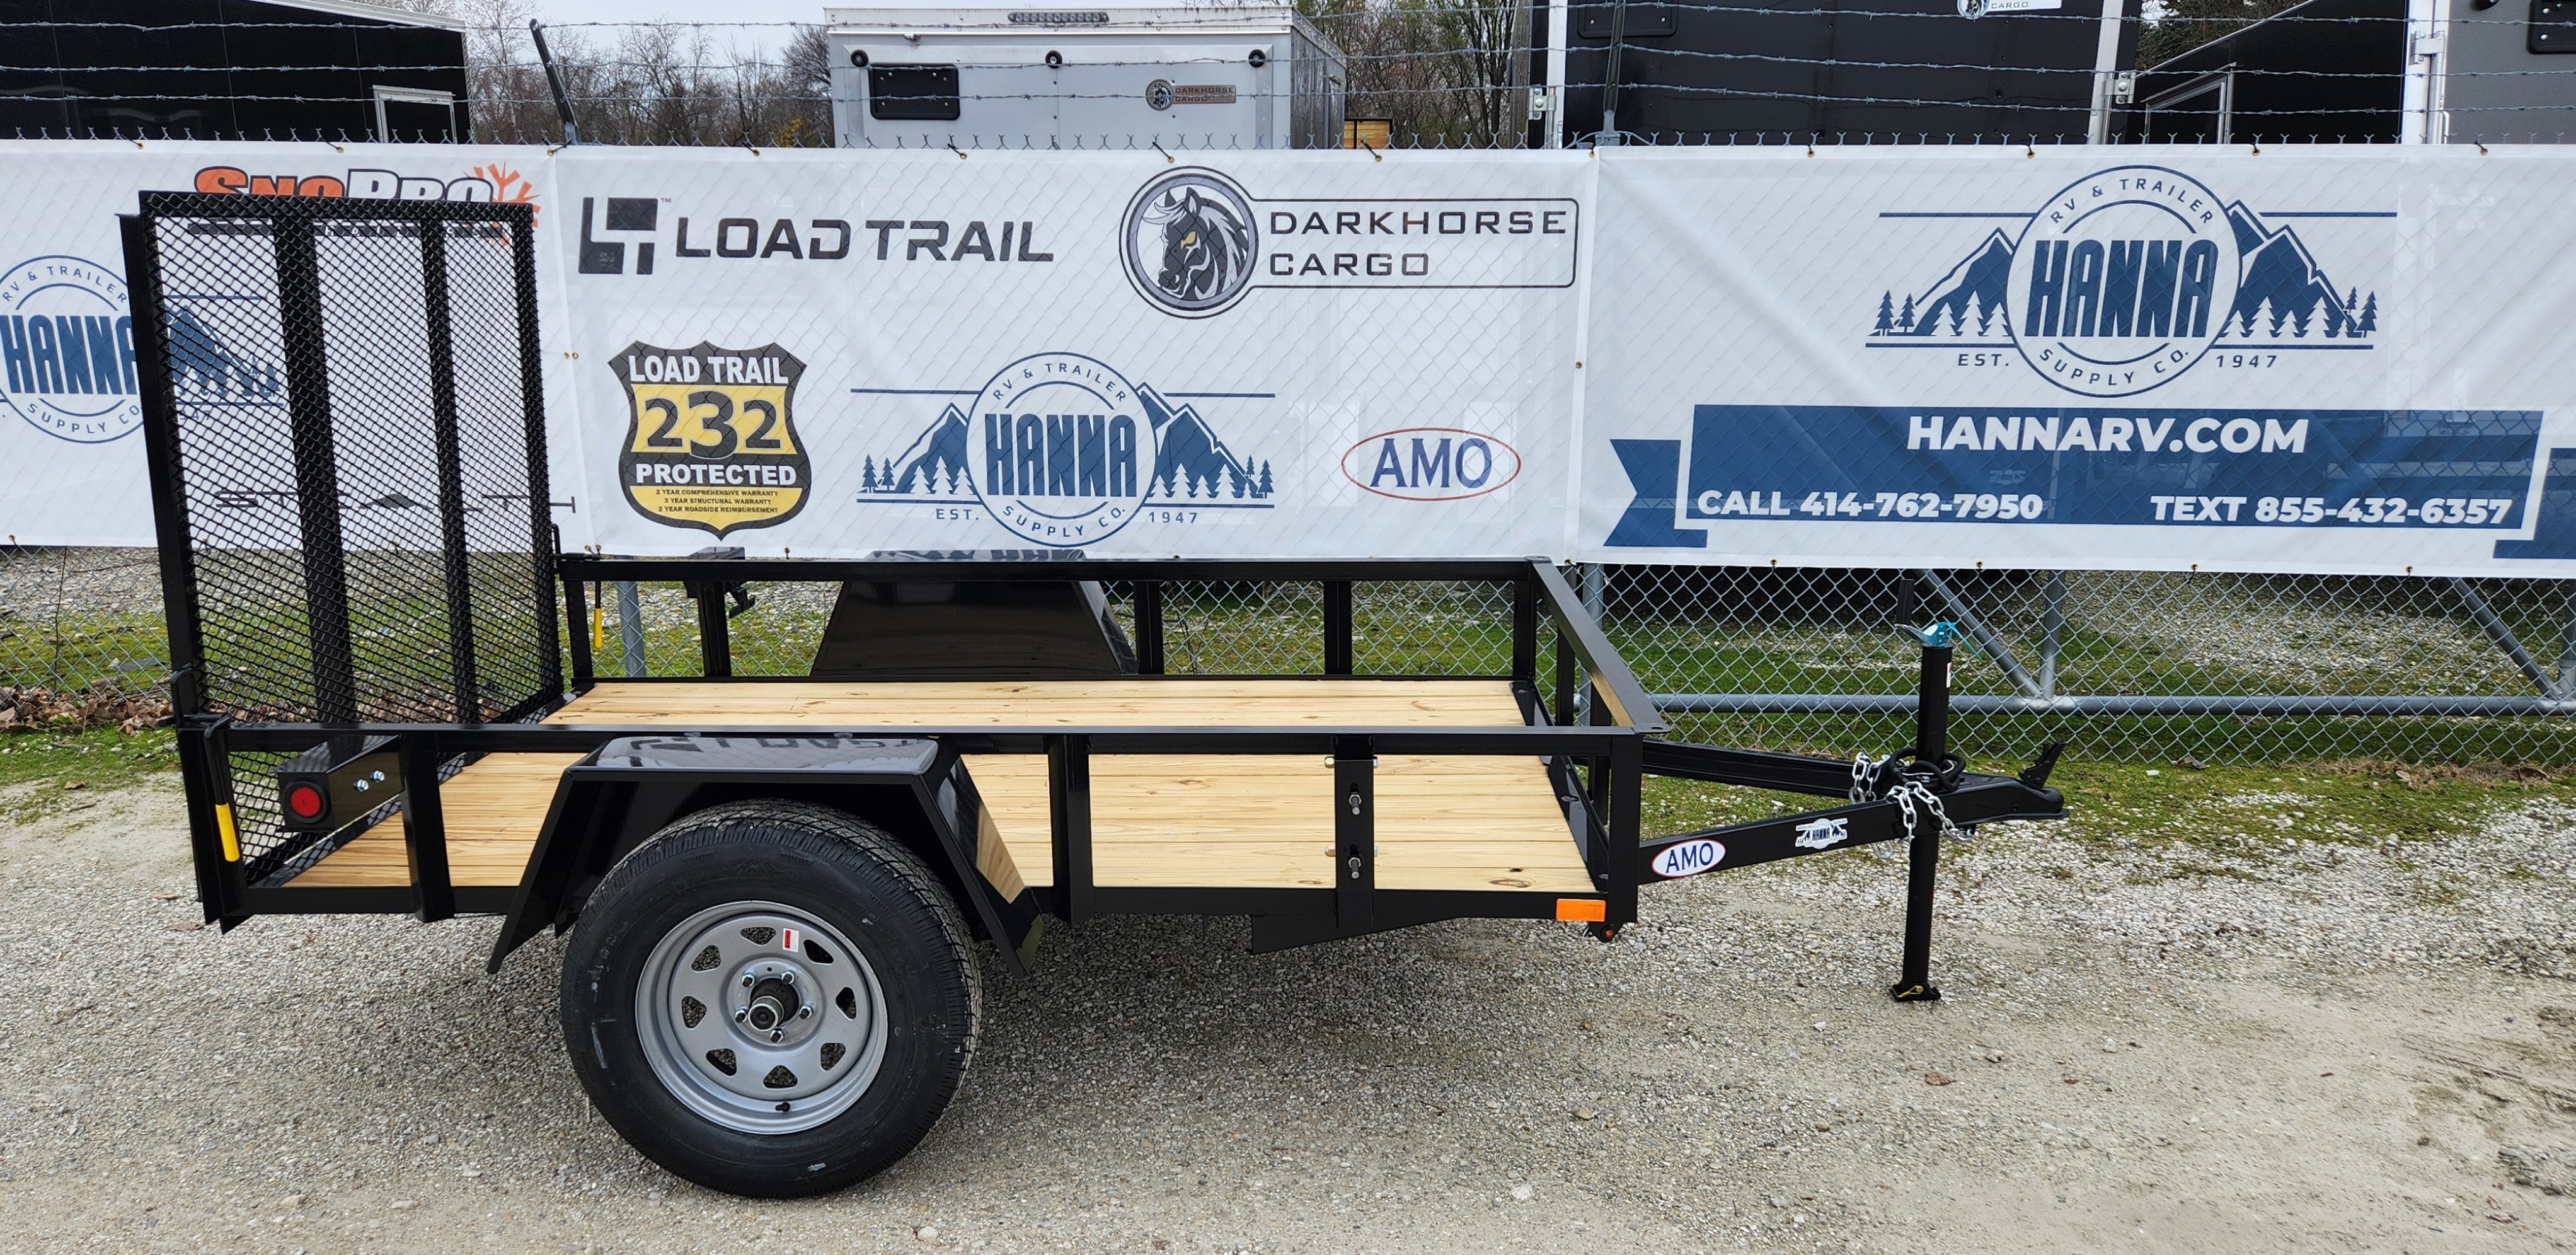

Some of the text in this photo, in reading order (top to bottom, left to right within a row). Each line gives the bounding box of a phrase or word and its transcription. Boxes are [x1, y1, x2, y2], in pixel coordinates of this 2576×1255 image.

[2050, 178, 2213, 223] RV & TRAILER
[1270, 210, 1567, 235] DARKHORSE
[676, 217, 1054, 261] LOAD TRAIL
[1270, 253, 1429, 276] CARGO
[2, 266, 127, 303] RV & TRAILER
[2024, 239, 2219, 337] HANNA
[0, 315, 137, 395] HANNA
[628, 355, 789, 384] LOAD TRAIL
[1958, 354, 2010, 366] EST.
[2039, 349, 2189, 386] SUPPLY CO.
[2217, 355, 2277, 367] 1947
[992, 362, 1127, 402] RV & TRAILER
[27, 403, 106, 433] SUPPLY
[644, 390, 782, 460] 232
[1907, 416, 2309, 453] HANNARV.COM
[985, 414, 1137, 497] HANNA
[1369, 437, 1492, 489] AMO
[636, 463, 796, 485] PROTECTED
[936, 509, 979, 521] EST.
[1148, 511, 1198, 524] 1947
[1697, 490, 2043, 520] CALL 414-762-7950
[2150, 495, 2512, 524] TEXT 855-432-6357
[1002, 505, 1126, 538] SUPPLY CO.
[1665, 842, 1714, 874] AMO
